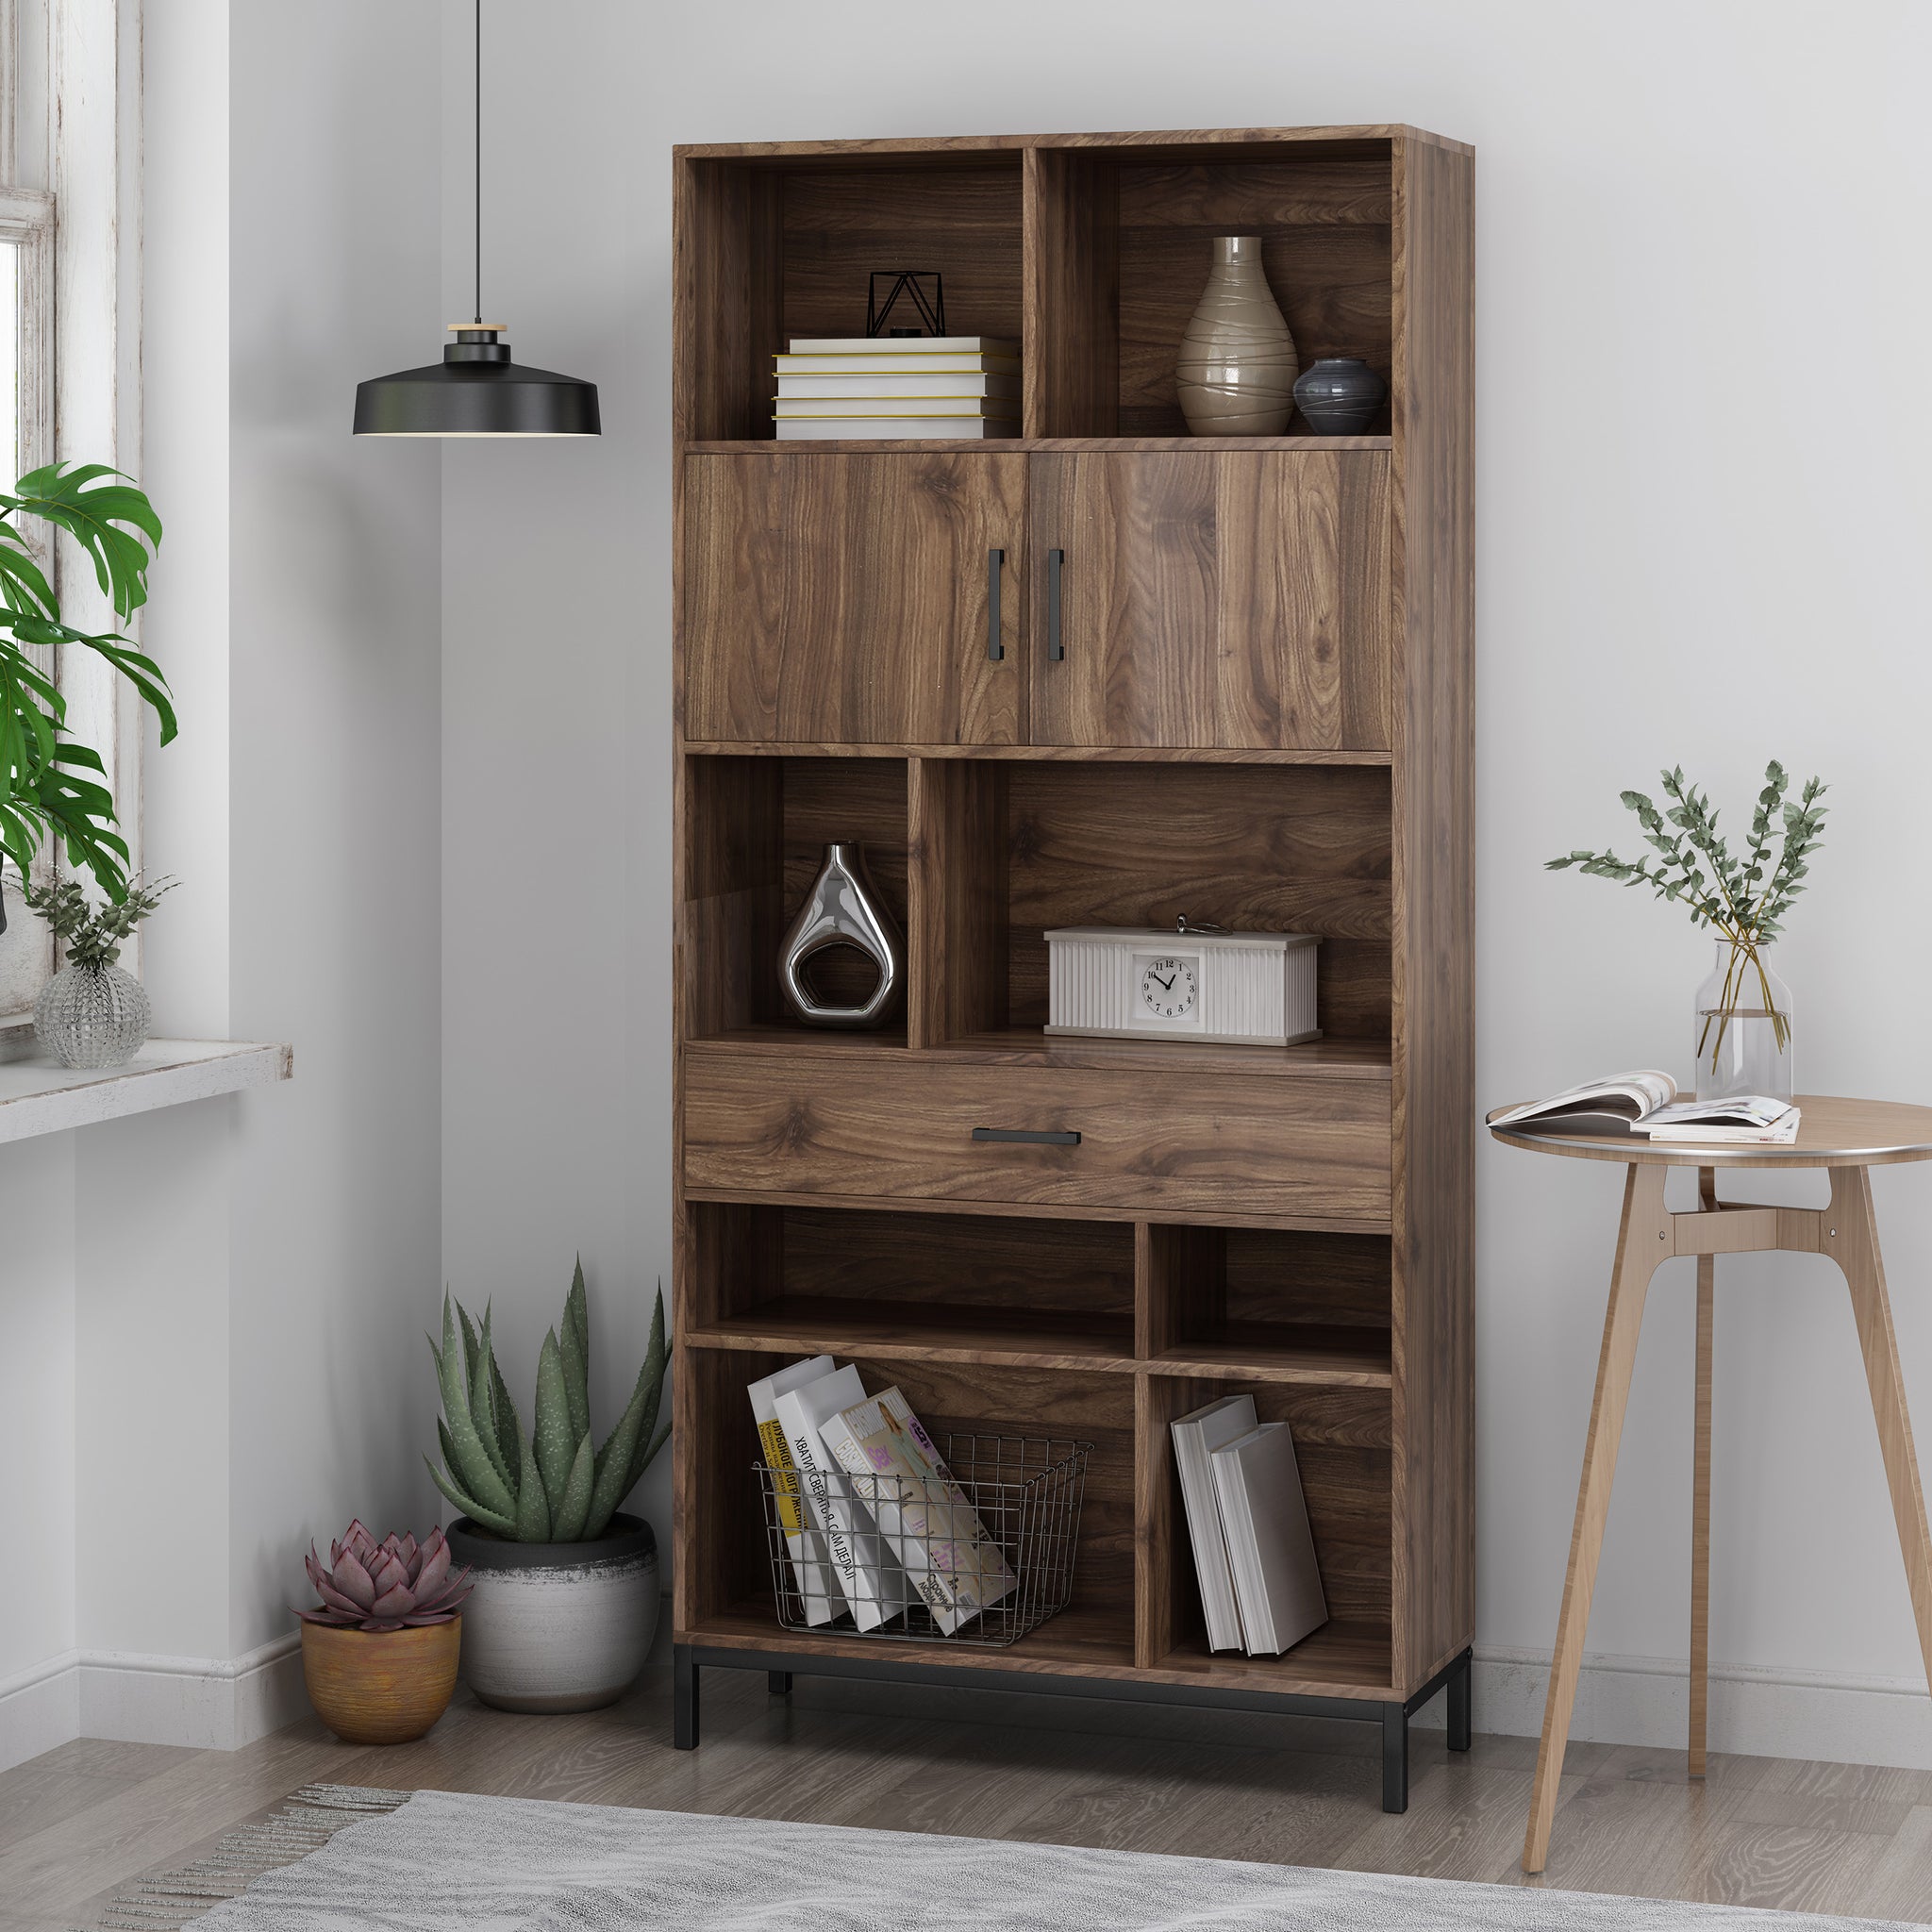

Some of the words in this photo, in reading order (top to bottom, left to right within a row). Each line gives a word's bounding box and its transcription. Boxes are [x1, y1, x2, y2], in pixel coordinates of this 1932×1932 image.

[1156, 962, 1163, 971] 11
[1147, 971, 1157, 979] 10
[1143, 982, 1149, 991] 9
[1189, 985, 1195, 993] 3
[1147, 994, 1153, 1003] 8
[1156, 1003, 1160, 1011] 7
[1166, 1008, 1172, 1016] 6
[771, 1420, 792, 1469] ГЛУБОКОЕ
[794, 1436, 817, 1472] ХВАТИТ
[824, 1513, 835, 1523] Я
[827, 1524, 844, 1547] САМ
[834, 1546, 857, 1580] ДЕЛАЛ
